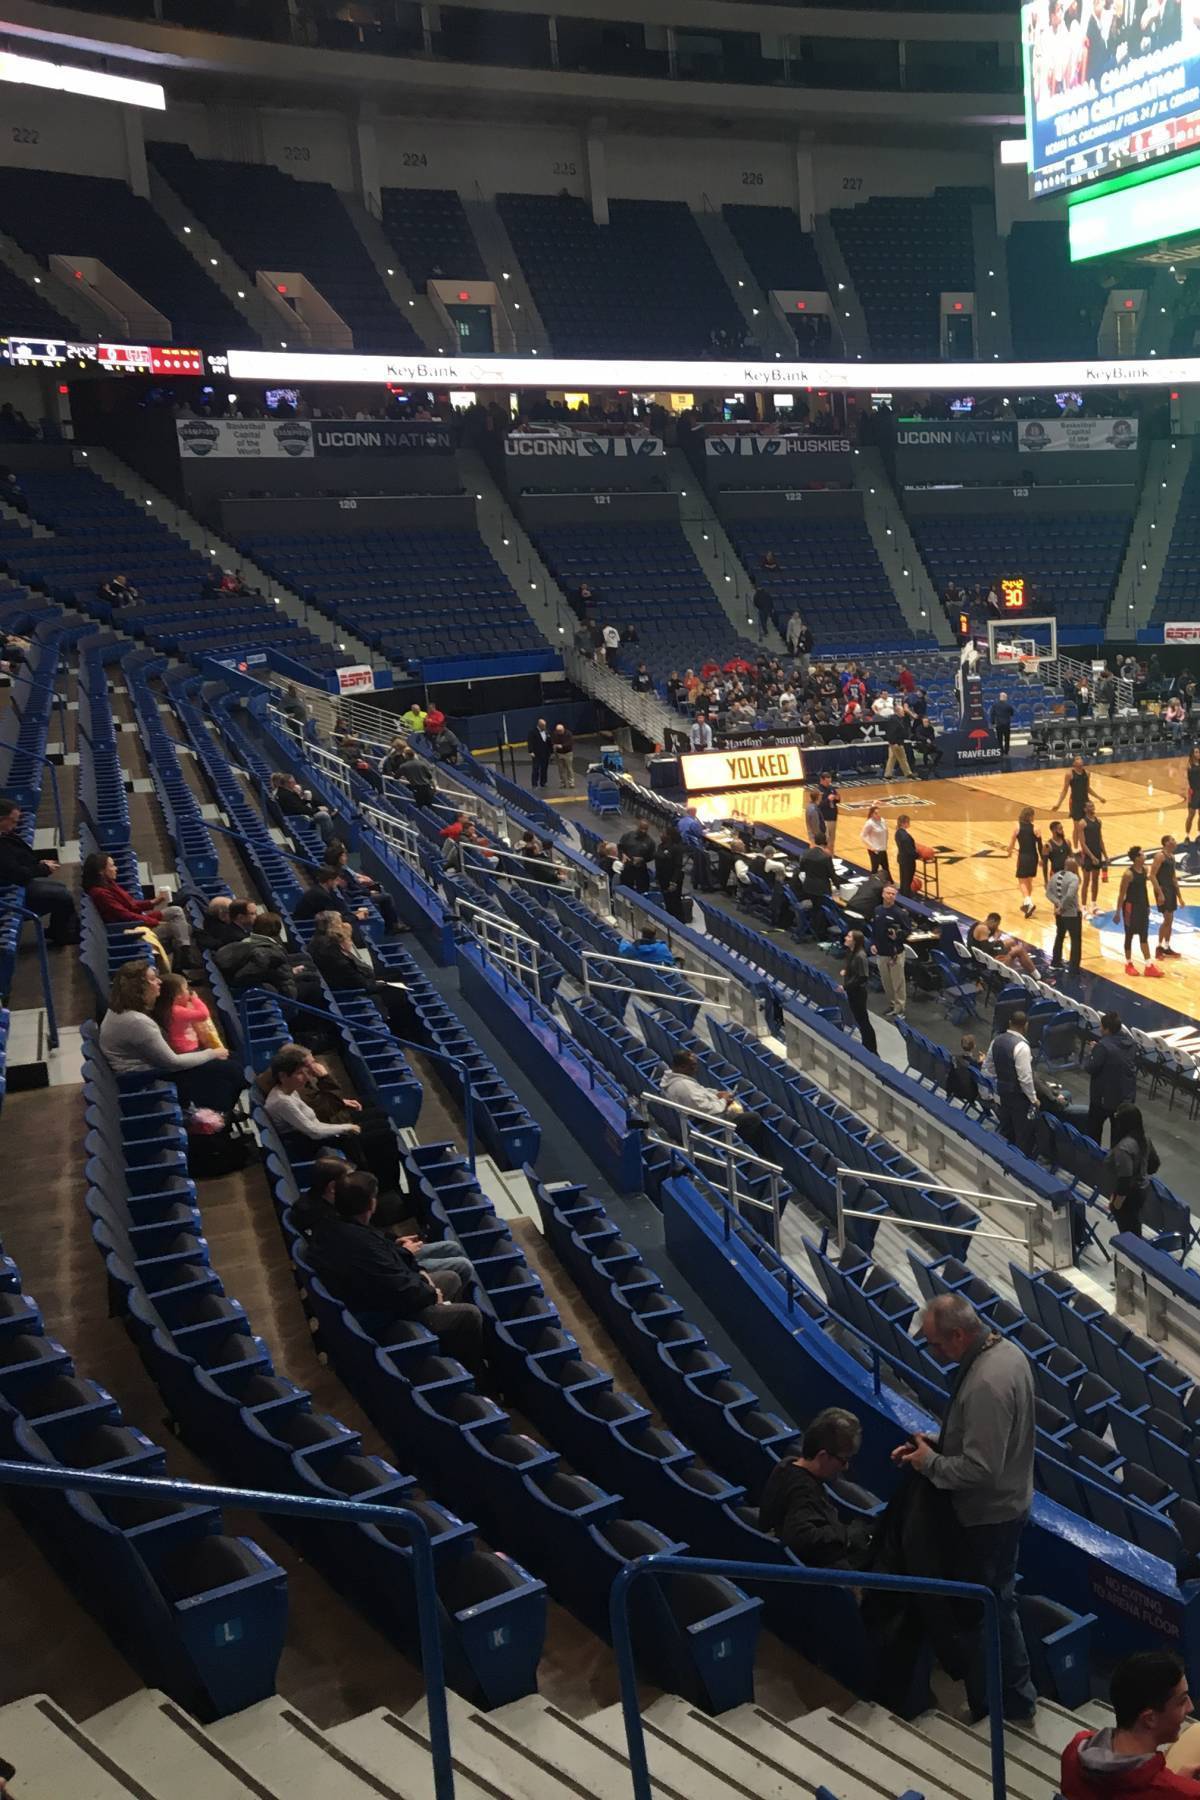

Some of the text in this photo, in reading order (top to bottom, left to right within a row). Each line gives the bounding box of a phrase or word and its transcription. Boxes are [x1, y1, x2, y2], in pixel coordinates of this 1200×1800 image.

[741, 172, 764, 186] 226
[841, 177, 863, 191] 227
[317, 432, 381, 447] UCONN
[897, 431, 951, 445] UCONN
[504, 439, 577, 456] UCONN
[786, 439, 850, 452] HUSKIES
[593, 496, 610, 504] 121
[1013, 489, 1029, 497] 123
[339, 500, 357, 508] 120
[1005, 589, 1023, 606] 30
[340, 676, 372, 688] ESPN
[957, 748, 1001, 760] TRAVELERS
[726, 754, 789, 780] YOLKED
[1143, 1610, 1180, 1638] FLOOR
[223, 1622, 235, 1642] L
[493, 1628, 505, 1646] K
[718, 1640, 730, 1660] J
